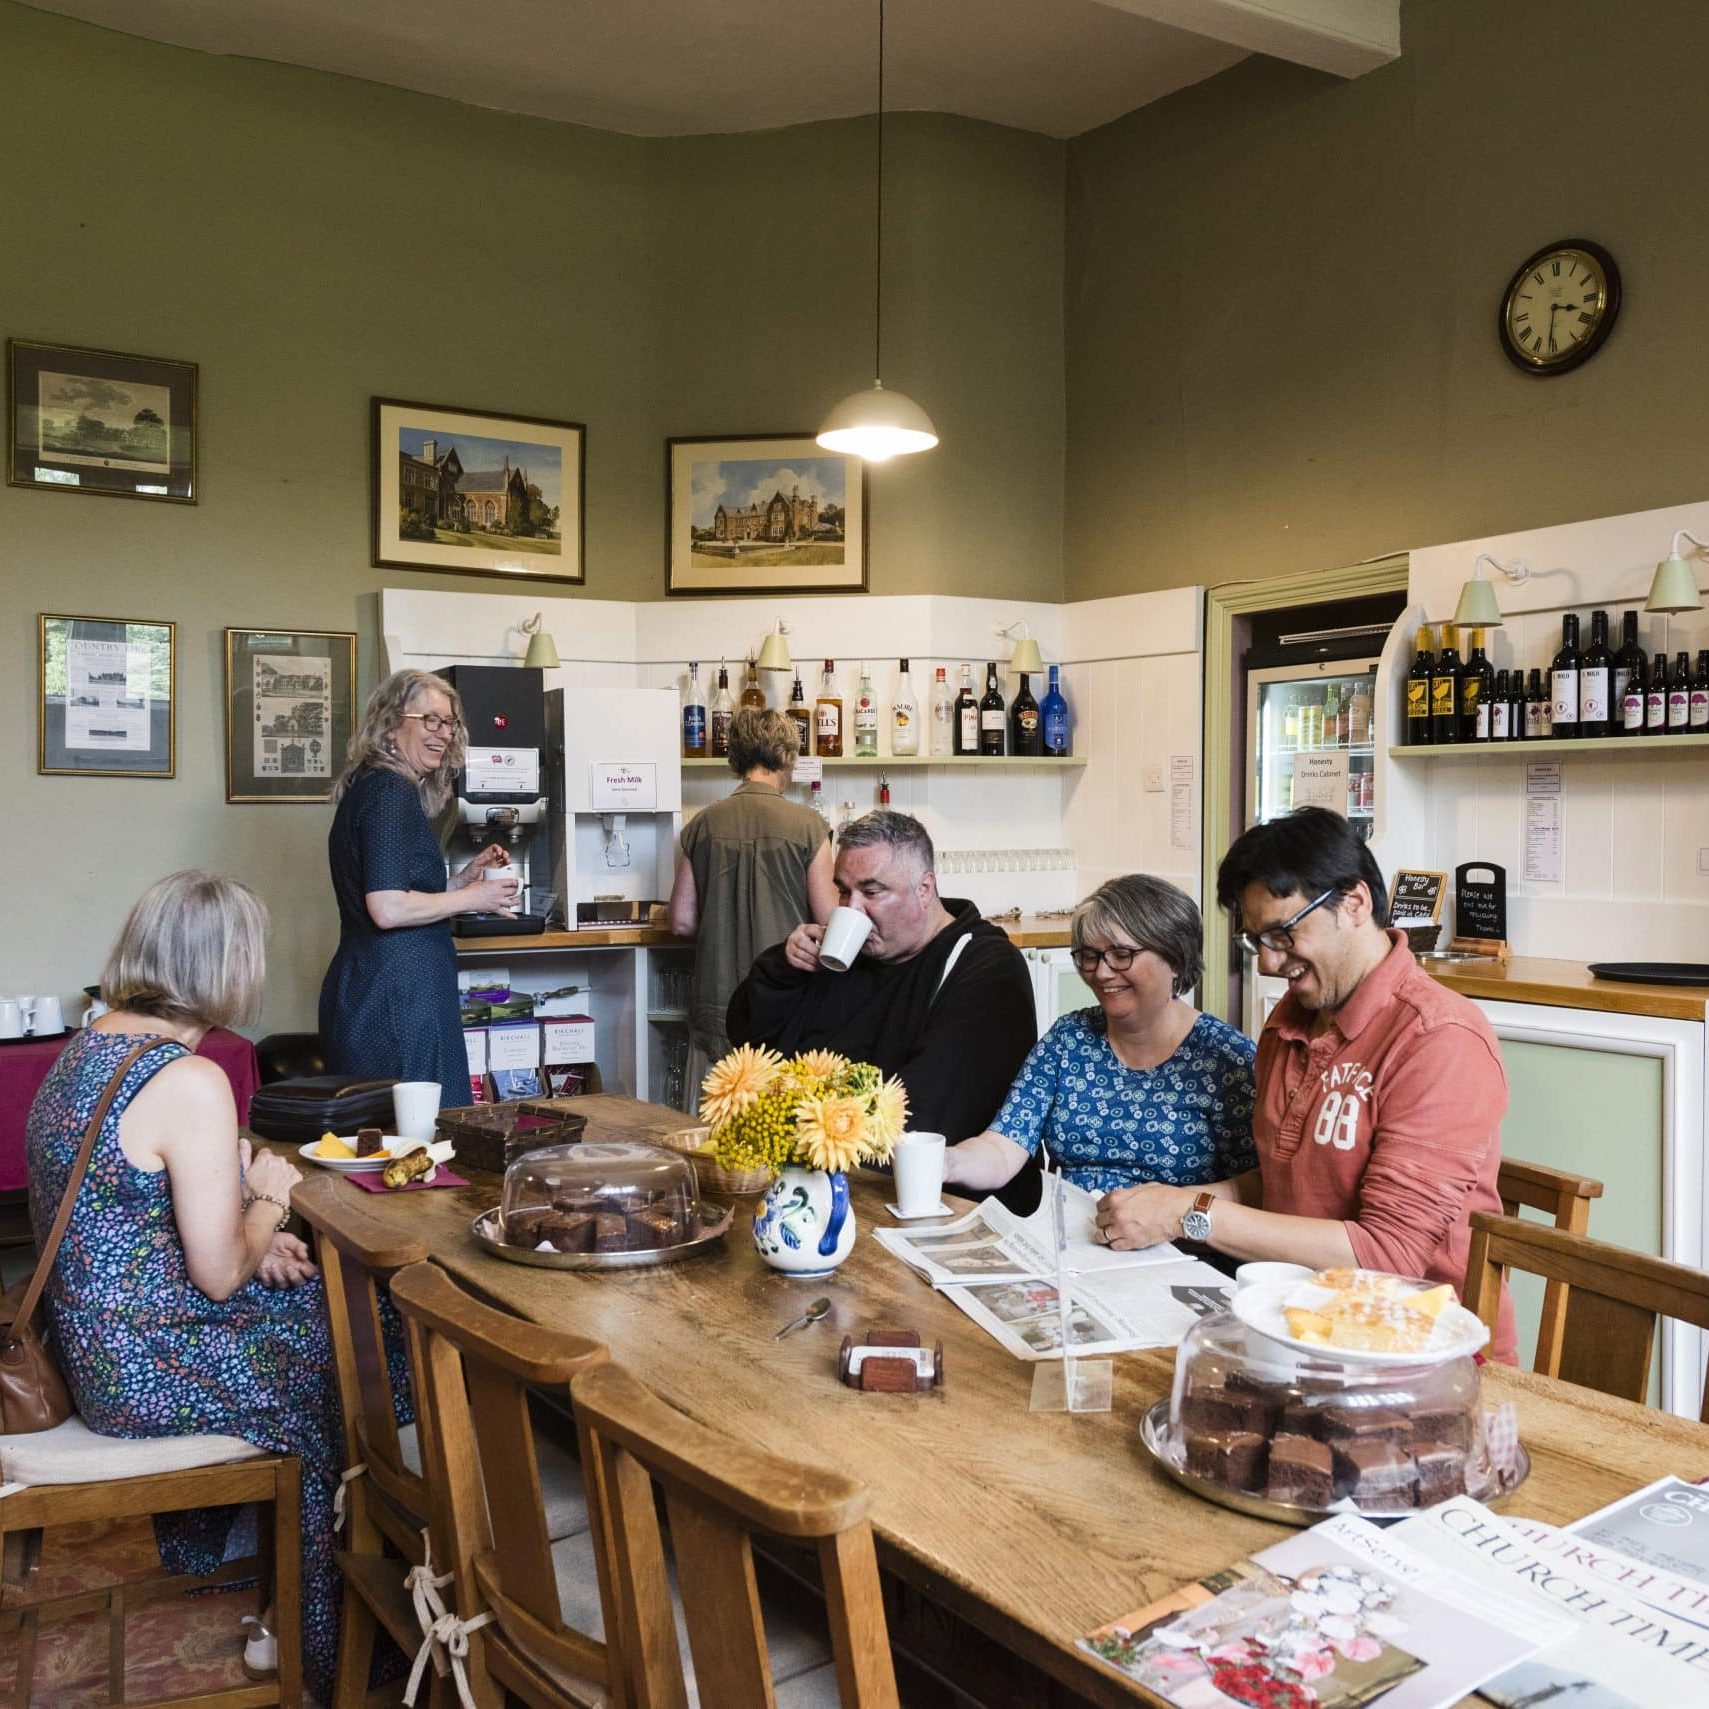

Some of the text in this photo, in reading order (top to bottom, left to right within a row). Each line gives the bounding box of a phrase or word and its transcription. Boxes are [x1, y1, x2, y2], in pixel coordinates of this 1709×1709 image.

[1301, 770, 1341, 778] Drinks Cabinet
[1309, 758, 1333, 766] Honesty
[606, 776, 642, 784] Fresh Milk
[1314, 1091, 1360, 1151] 88
[1440, 1508, 1608, 1612] CHURCH
[1511, 1524, 1656, 1589] URCH
